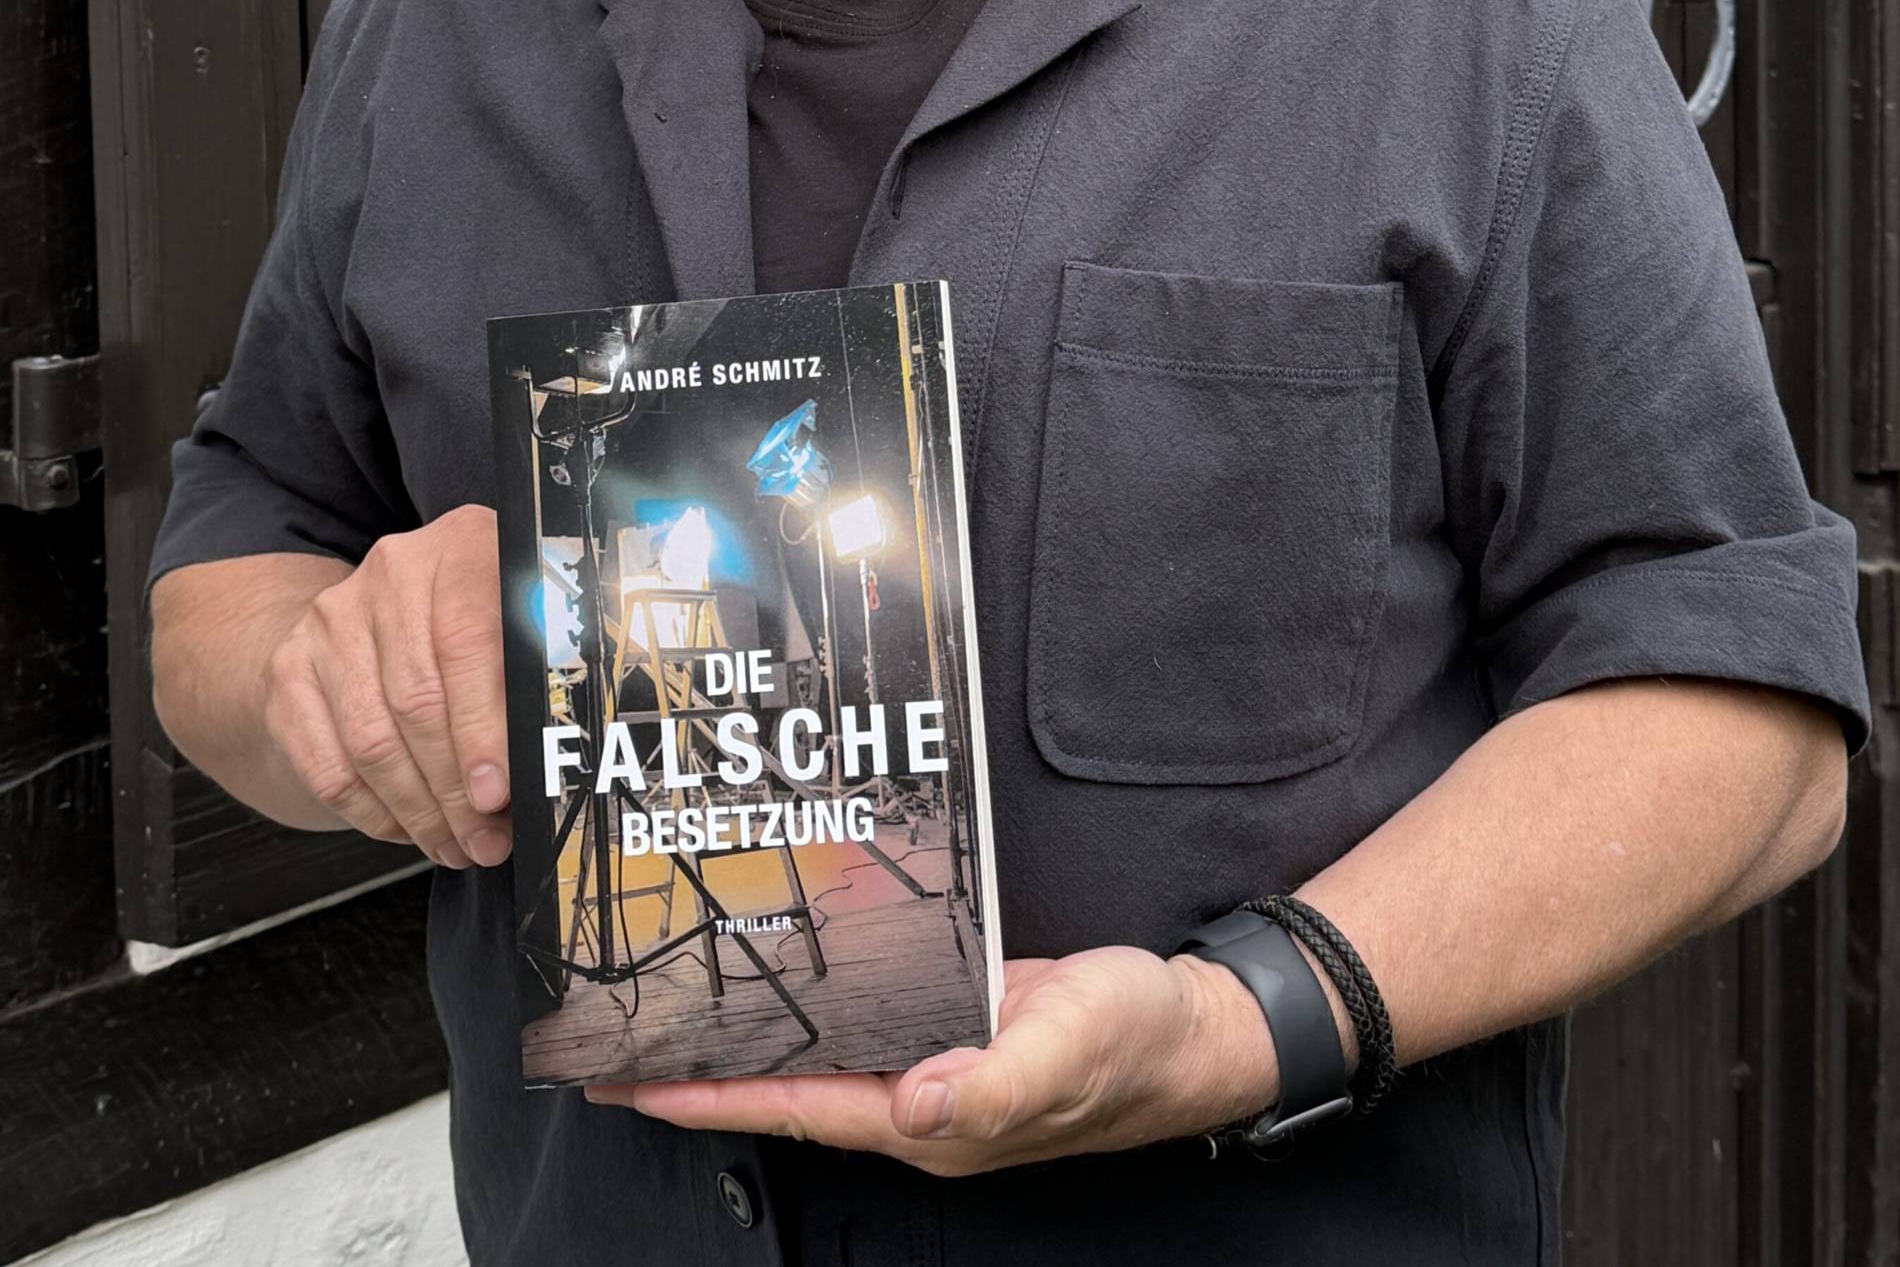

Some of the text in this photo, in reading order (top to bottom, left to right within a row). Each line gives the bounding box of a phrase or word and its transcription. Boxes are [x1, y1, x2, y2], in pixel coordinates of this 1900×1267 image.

[620, 356, 822, 393] ANDRÉ SCHMITZ
[705, 649, 774, 696] DIE
[542, 700, 949, 797] FALSCHE
[622, 799, 875, 857] BESETZUNG
[715, 915, 792, 934] THRILLER
